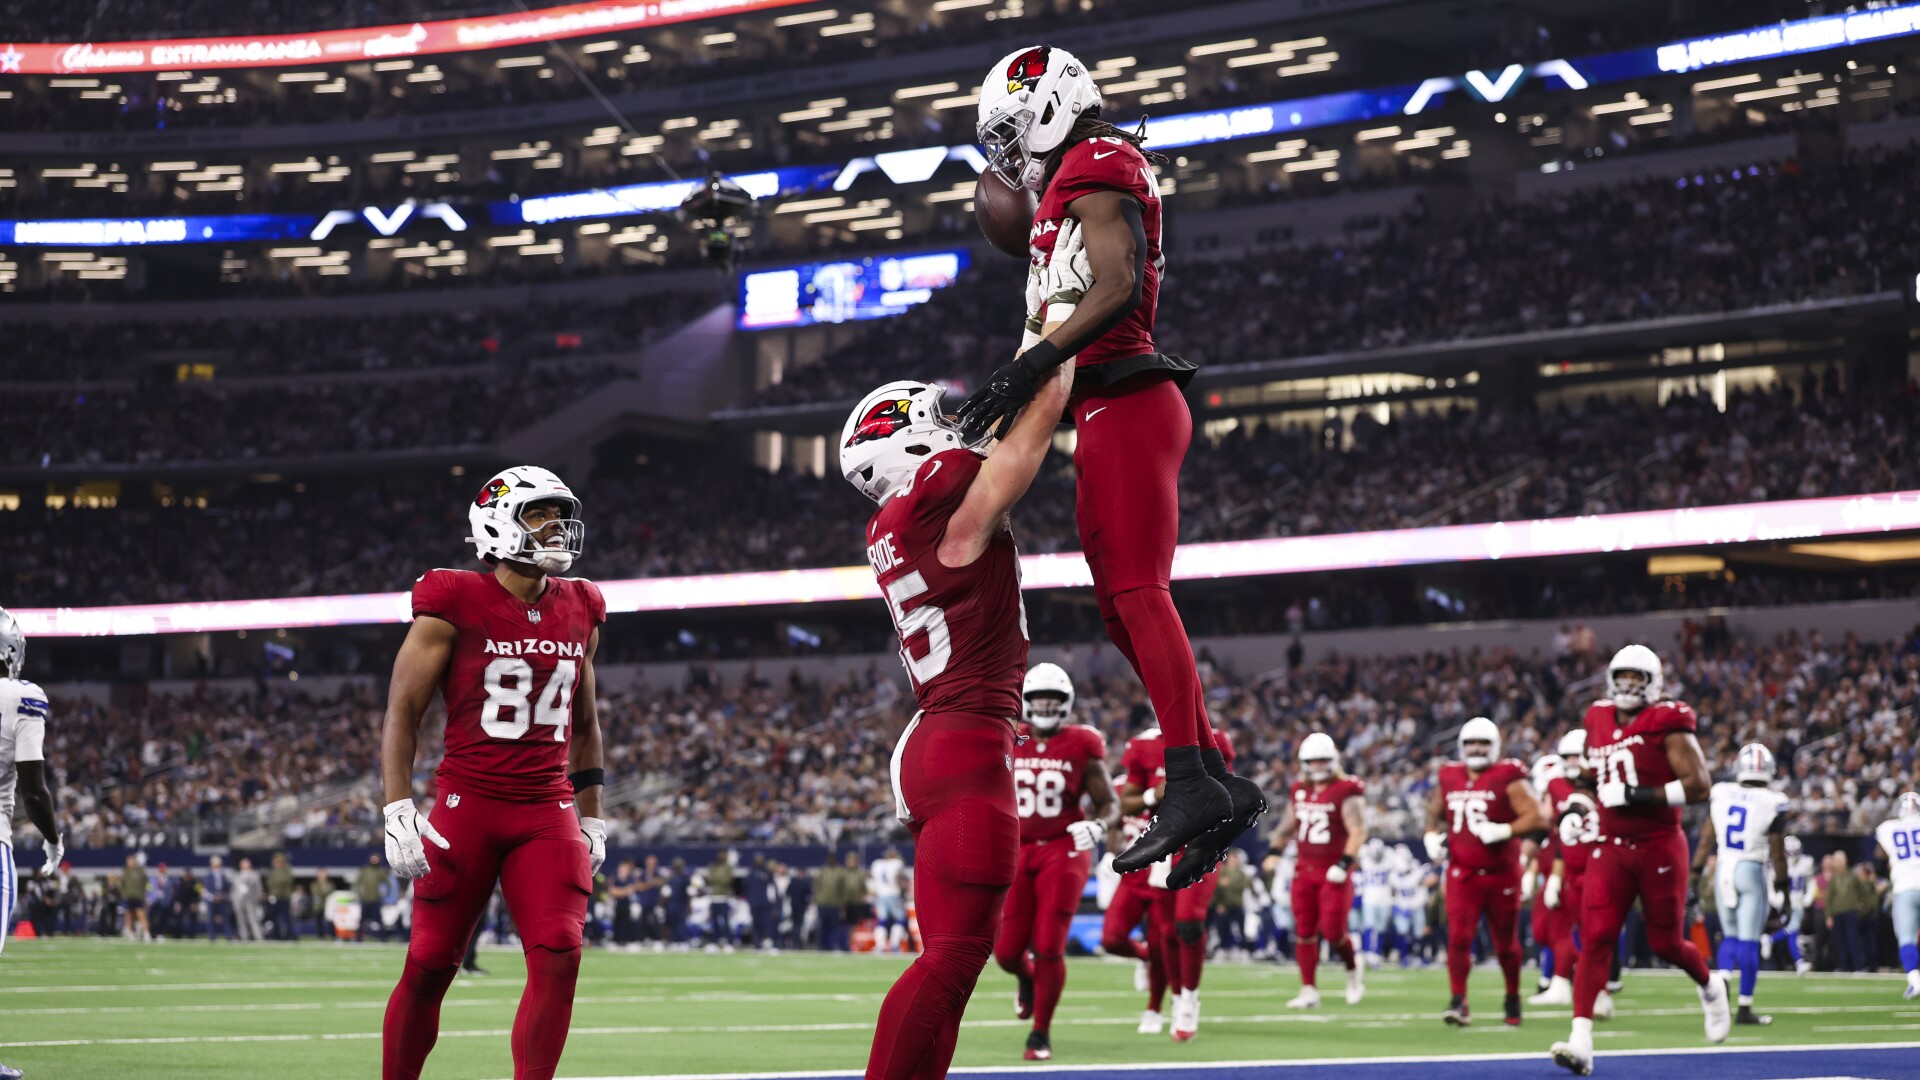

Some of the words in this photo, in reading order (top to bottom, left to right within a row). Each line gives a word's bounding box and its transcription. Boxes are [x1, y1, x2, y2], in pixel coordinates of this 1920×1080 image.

[151, 38, 322, 65] EXTRAVAGANZA
[484, 638, 584, 658] ARIZONA
[884, 569, 952, 691] 5
[481, 658, 576, 742] 84
[1014, 757, 1073, 773] RIZONA
[1014, 769, 1066, 818] 68
[1295, 810, 1331, 844] 72
[1726, 805, 1747, 850] 2
